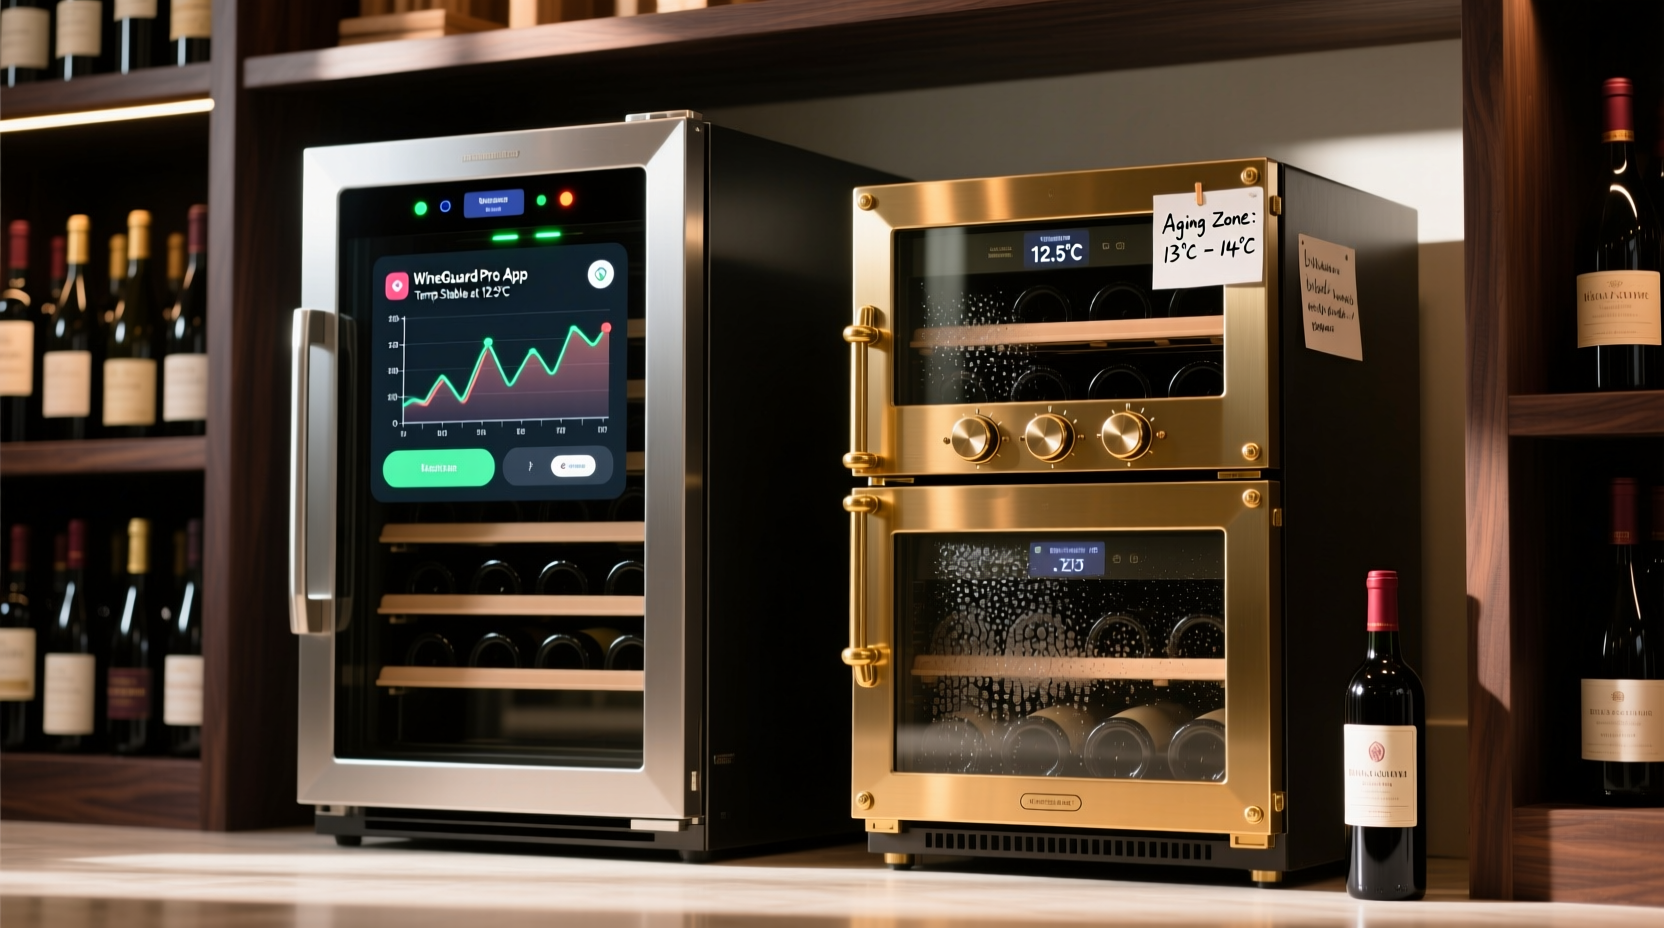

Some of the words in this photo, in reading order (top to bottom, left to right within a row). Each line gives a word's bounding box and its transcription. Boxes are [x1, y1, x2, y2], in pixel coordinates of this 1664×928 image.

[1162, 212, 1206, 241] Aging
[1212, 211, 1256, 228] Zone:
[1031, 243, 1083, 263] 12.5°C
[1164, 242, 1197, 264] 13°C
[1220, 236, 1255, 258] 14°C
[480, 269, 500, 282] Pro
[503, 267, 528, 284] App
